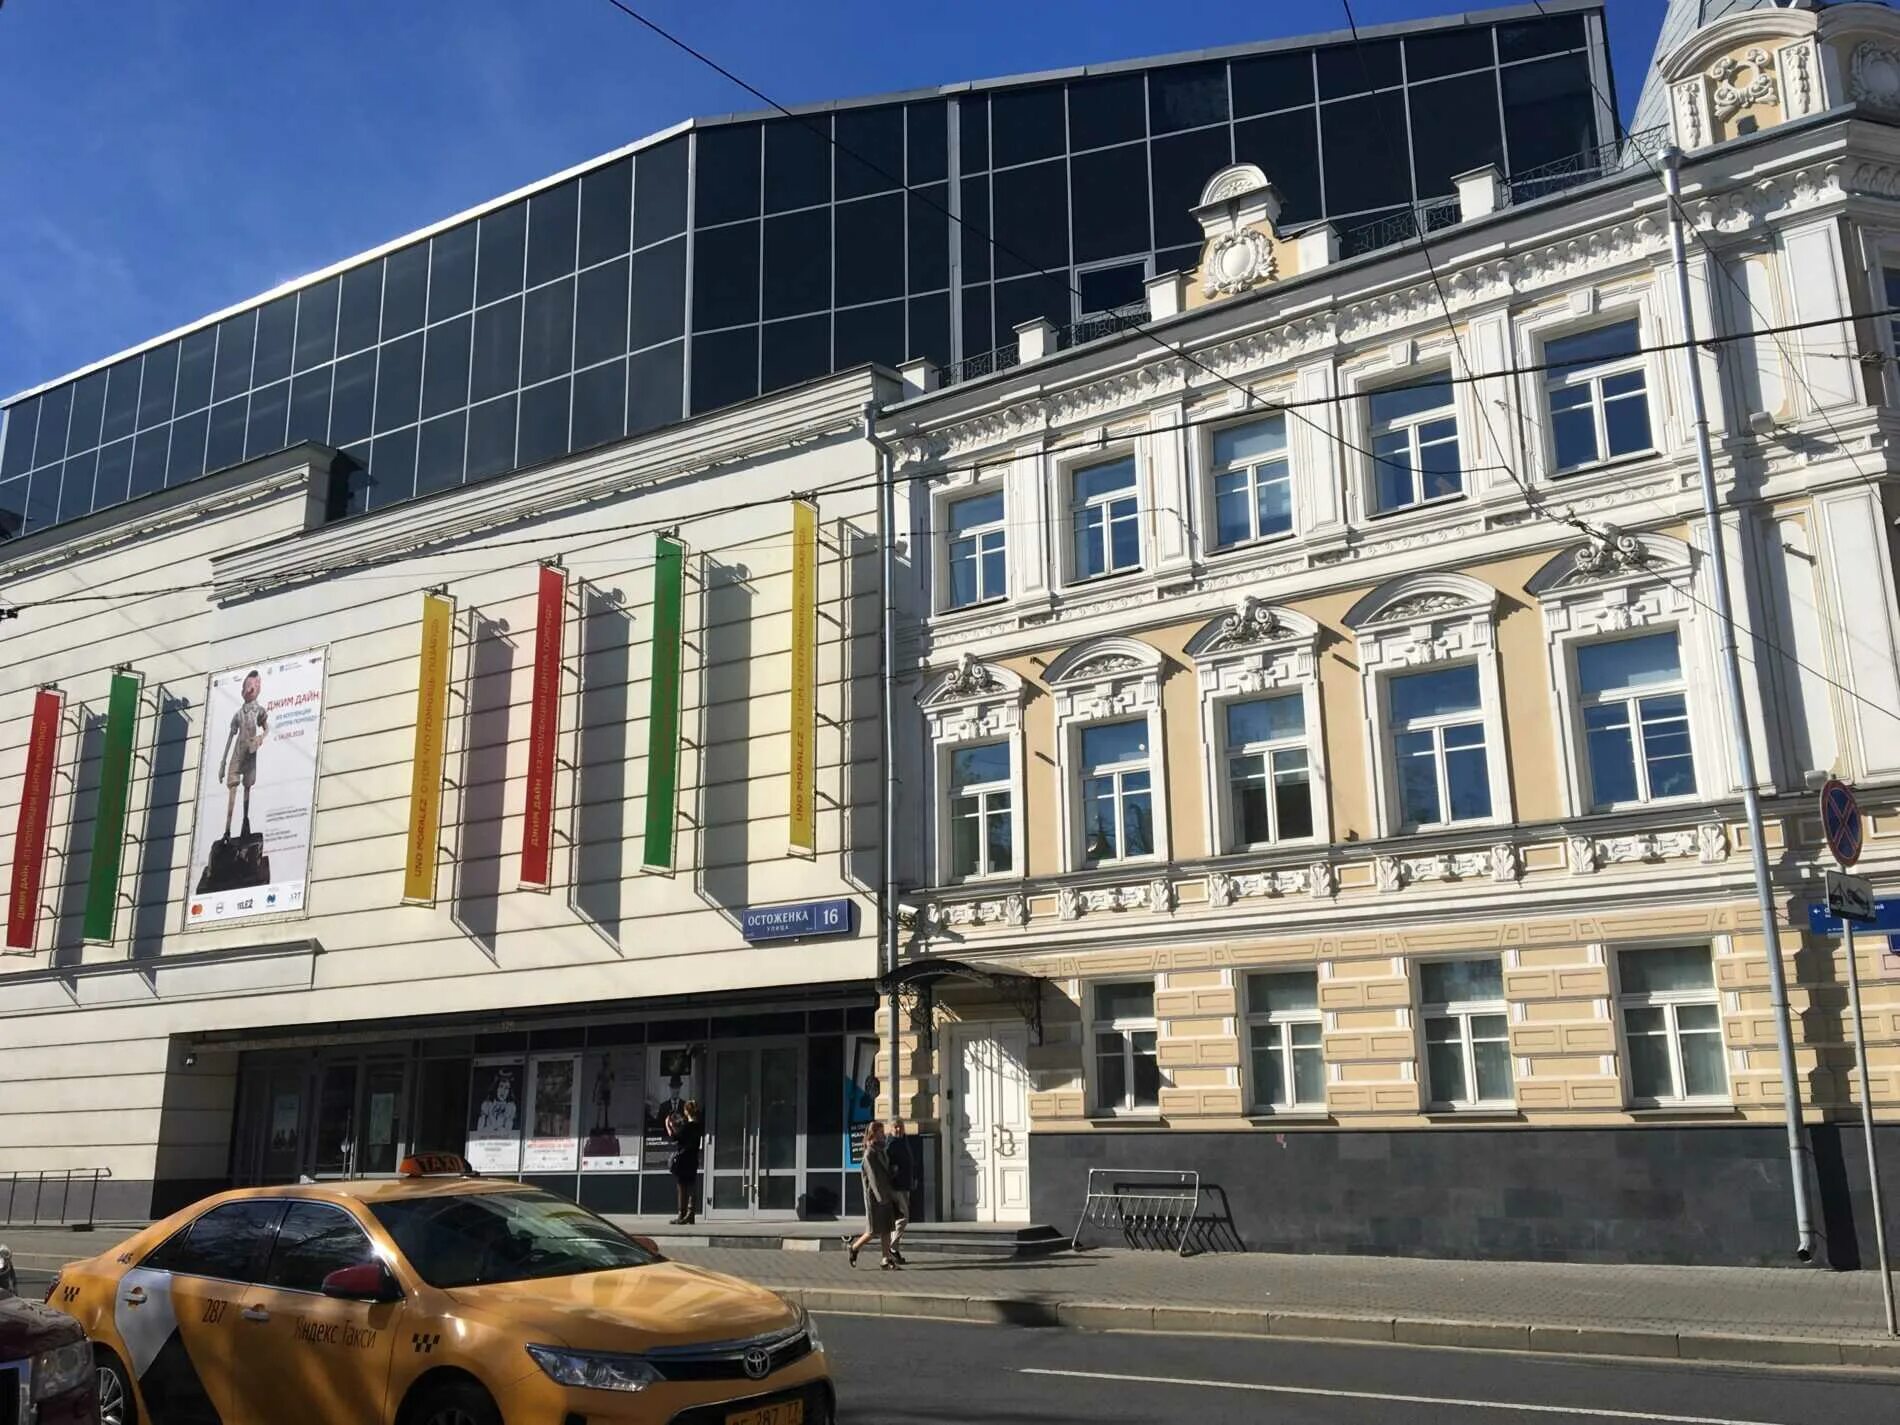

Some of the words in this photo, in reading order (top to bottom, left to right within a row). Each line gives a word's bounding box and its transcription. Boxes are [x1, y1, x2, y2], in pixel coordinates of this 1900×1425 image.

[266, 696, 294, 712] ДЖИМ
[295, 690, 319, 706] ДАЙН
[796, 728, 805, 792] MORALEZ
[796, 795, 804, 822] UNO
[416, 798, 427, 851] MORALEZ
[530, 811, 540, 847] ДЖИМ
[414, 853, 424, 877] UNO
[237, 898, 254, 911] TELE2
[823, 908, 839, 925] 16
[748, 911, 809, 926] ОСТОЖЕНКА
[422, 1155, 463, 1174] TAXI
[201, 1298, 228, 1325] 287
[294, 1315, 339, 1345] Яндекс
[342, 1320, 377, 1349] Такси
